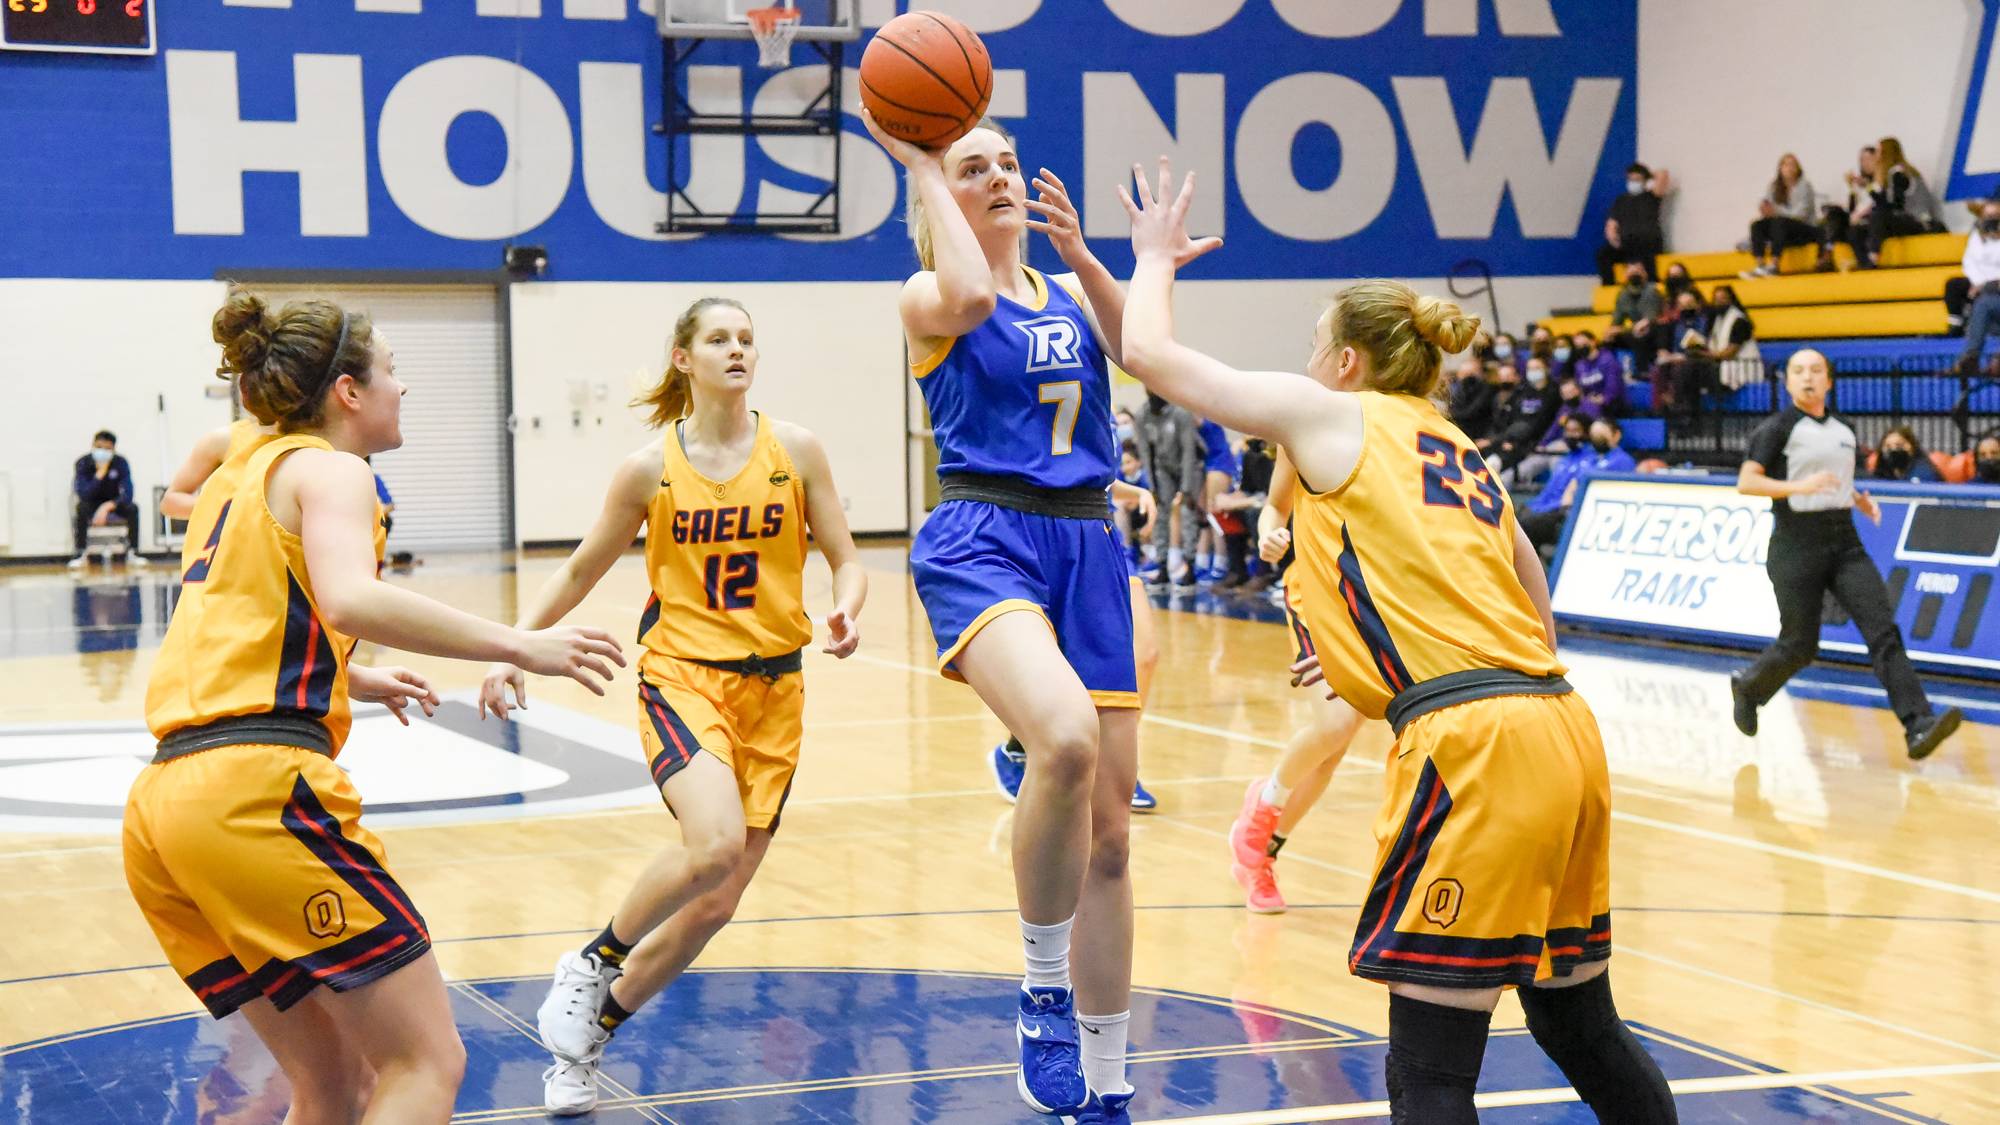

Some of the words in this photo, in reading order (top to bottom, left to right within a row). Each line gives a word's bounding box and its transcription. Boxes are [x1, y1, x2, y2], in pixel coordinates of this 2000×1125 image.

[1082, 71, 1622, 241] NOW
[1011, 315, 1083, 373] R
[1038, 380, 1082, 456] 7
[1416, 430, 1505, 530] 23
[672, 502, 785, 545] GAELS
[704, 550, 760, 611] 12
[1611, 568, 1718, 609] RAMS
[303, 888, 347, 939] Q
[1422, 877, 1464, 930] Q
